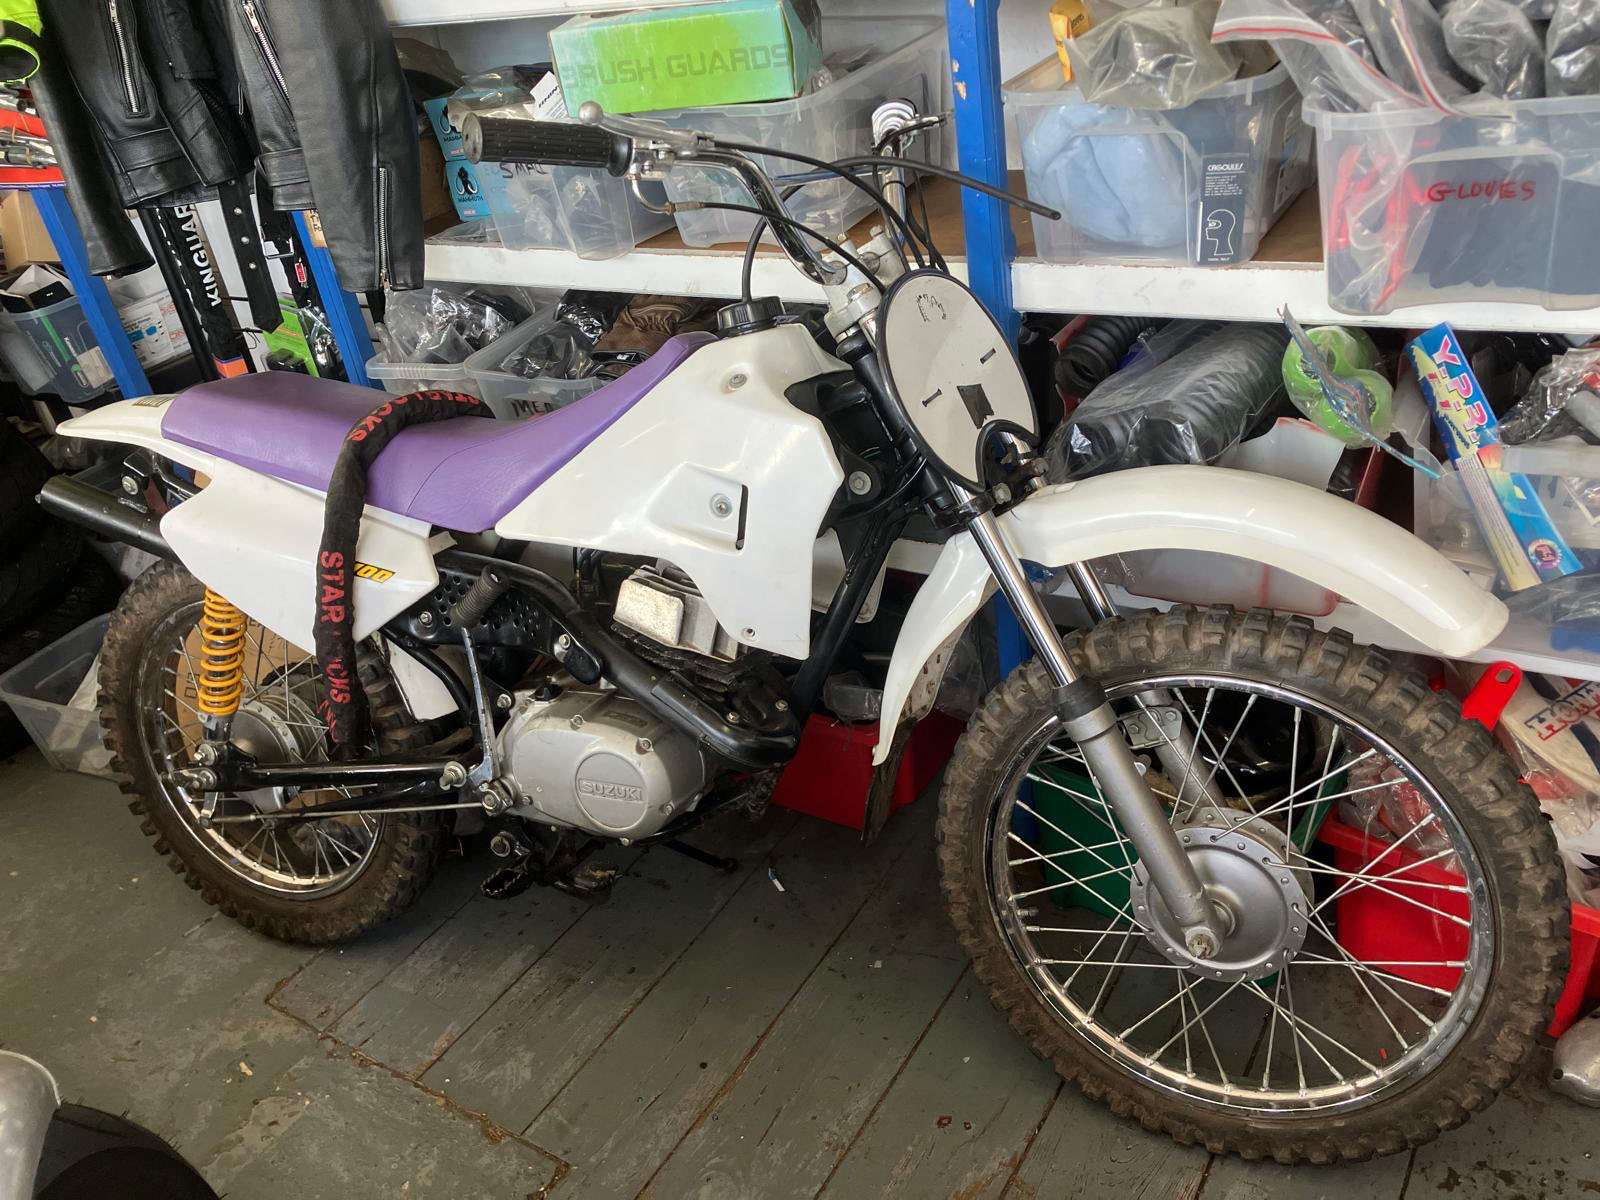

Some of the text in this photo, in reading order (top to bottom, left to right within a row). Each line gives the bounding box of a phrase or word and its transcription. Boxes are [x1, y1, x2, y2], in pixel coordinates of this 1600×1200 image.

[561, 43, 791, 89] BRUSH GUARDS
[1427, 180, 1536, 202] GLOVES
[320, 550, 345, 624] STAR
[582, 781, 642, 800] SUZUKI
